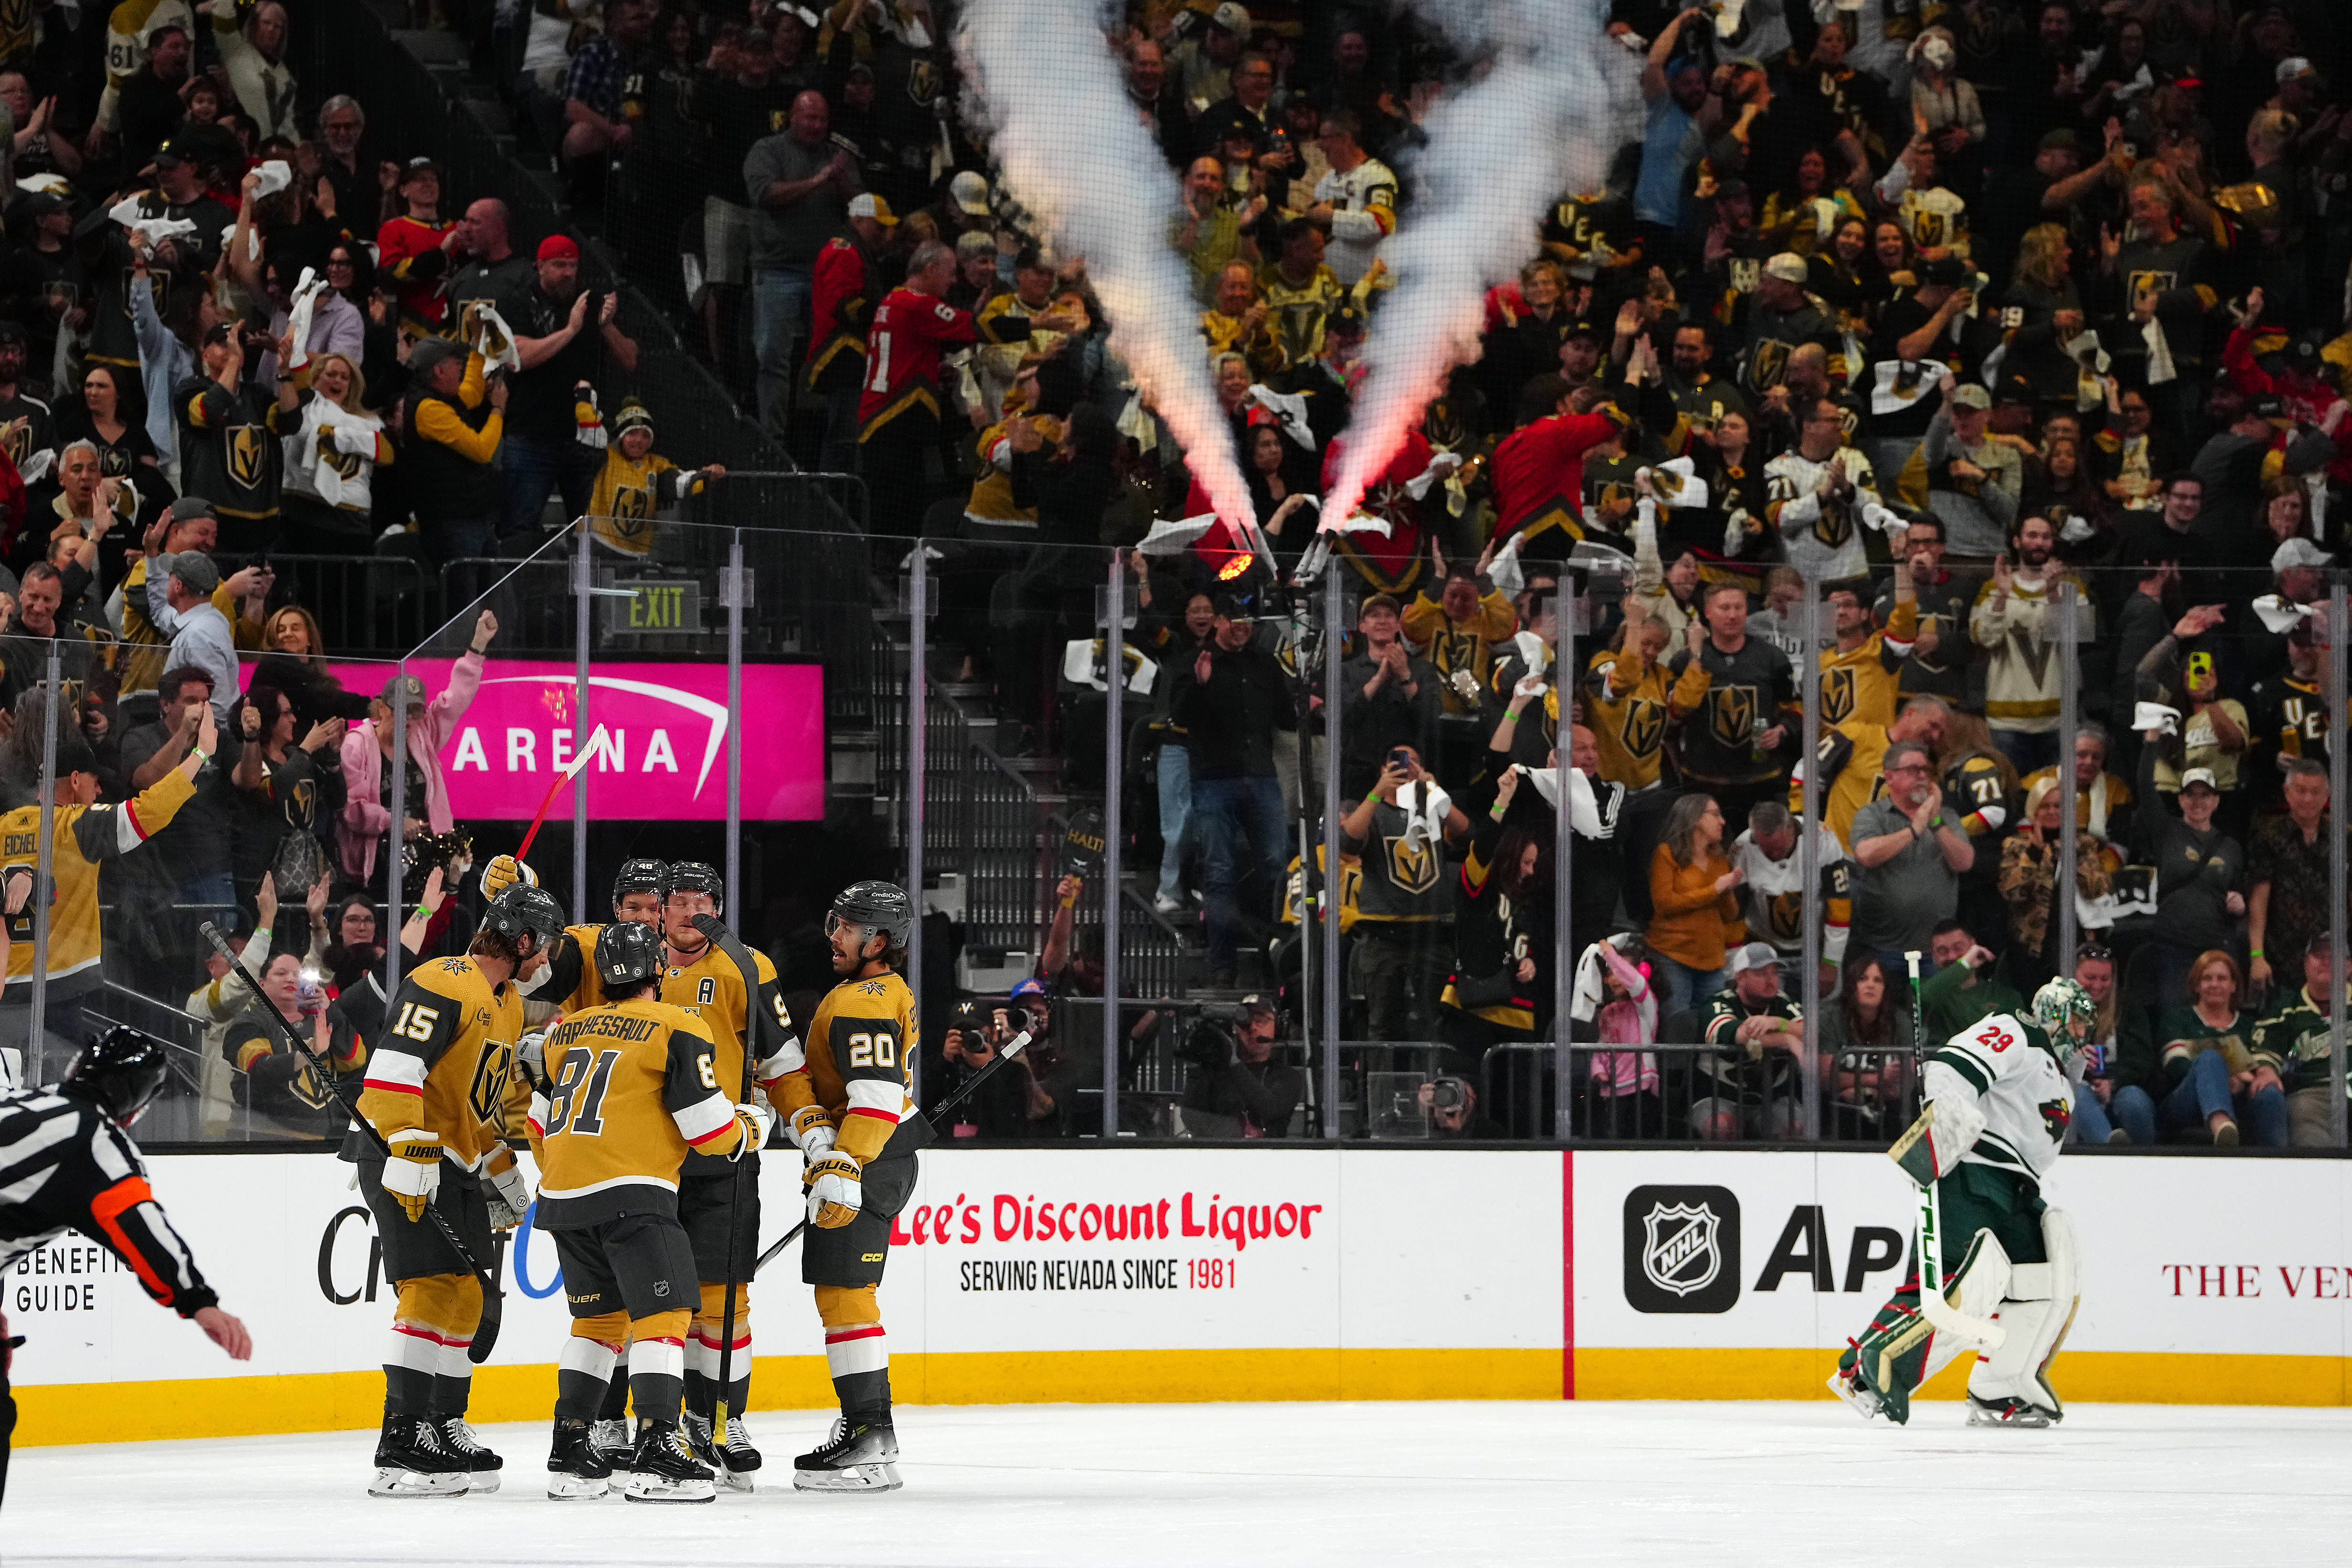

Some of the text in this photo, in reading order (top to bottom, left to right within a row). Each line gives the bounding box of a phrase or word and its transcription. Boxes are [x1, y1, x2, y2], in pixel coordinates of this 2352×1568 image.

[111, 46, 133, 68] 61
[1767, 477, 1792, 500] 71
[630, 587, 684, 627] EXIT
[452, 727, 679, 773] ARENA
[1970, 778, 2004, 804] 71
[5, 833, 38, 856] EICHEL
[612, 963, 627, 976] 81
[697, 976, 716, 1005] A
[392, 1001, 441, 1042] 15
[773, 992, 792, 1028] 9
[849, 1032, 895, 1068] 20
[1977, 1026, 2013, 1052] 29
[695, 1053, 716, 1089] 8
[544, 1047, 622, 1140] 81
[889, 1192, 1322, 1251] Lee's Discount Liquor
[1660, 1227, 1708, 1275] NHL
[1920, 1187, 1938, 1290] TRUE
[960, 1258, 1235, 1291] SERVING NEVADA SINCE 1981
[2161, 1264, 2262, 1298] THE
[17, 1285, 95, 1312] GUIDE
[568, 1293, 601, 1304] AUER
[823, 1447, 850, 1464] BAUER
